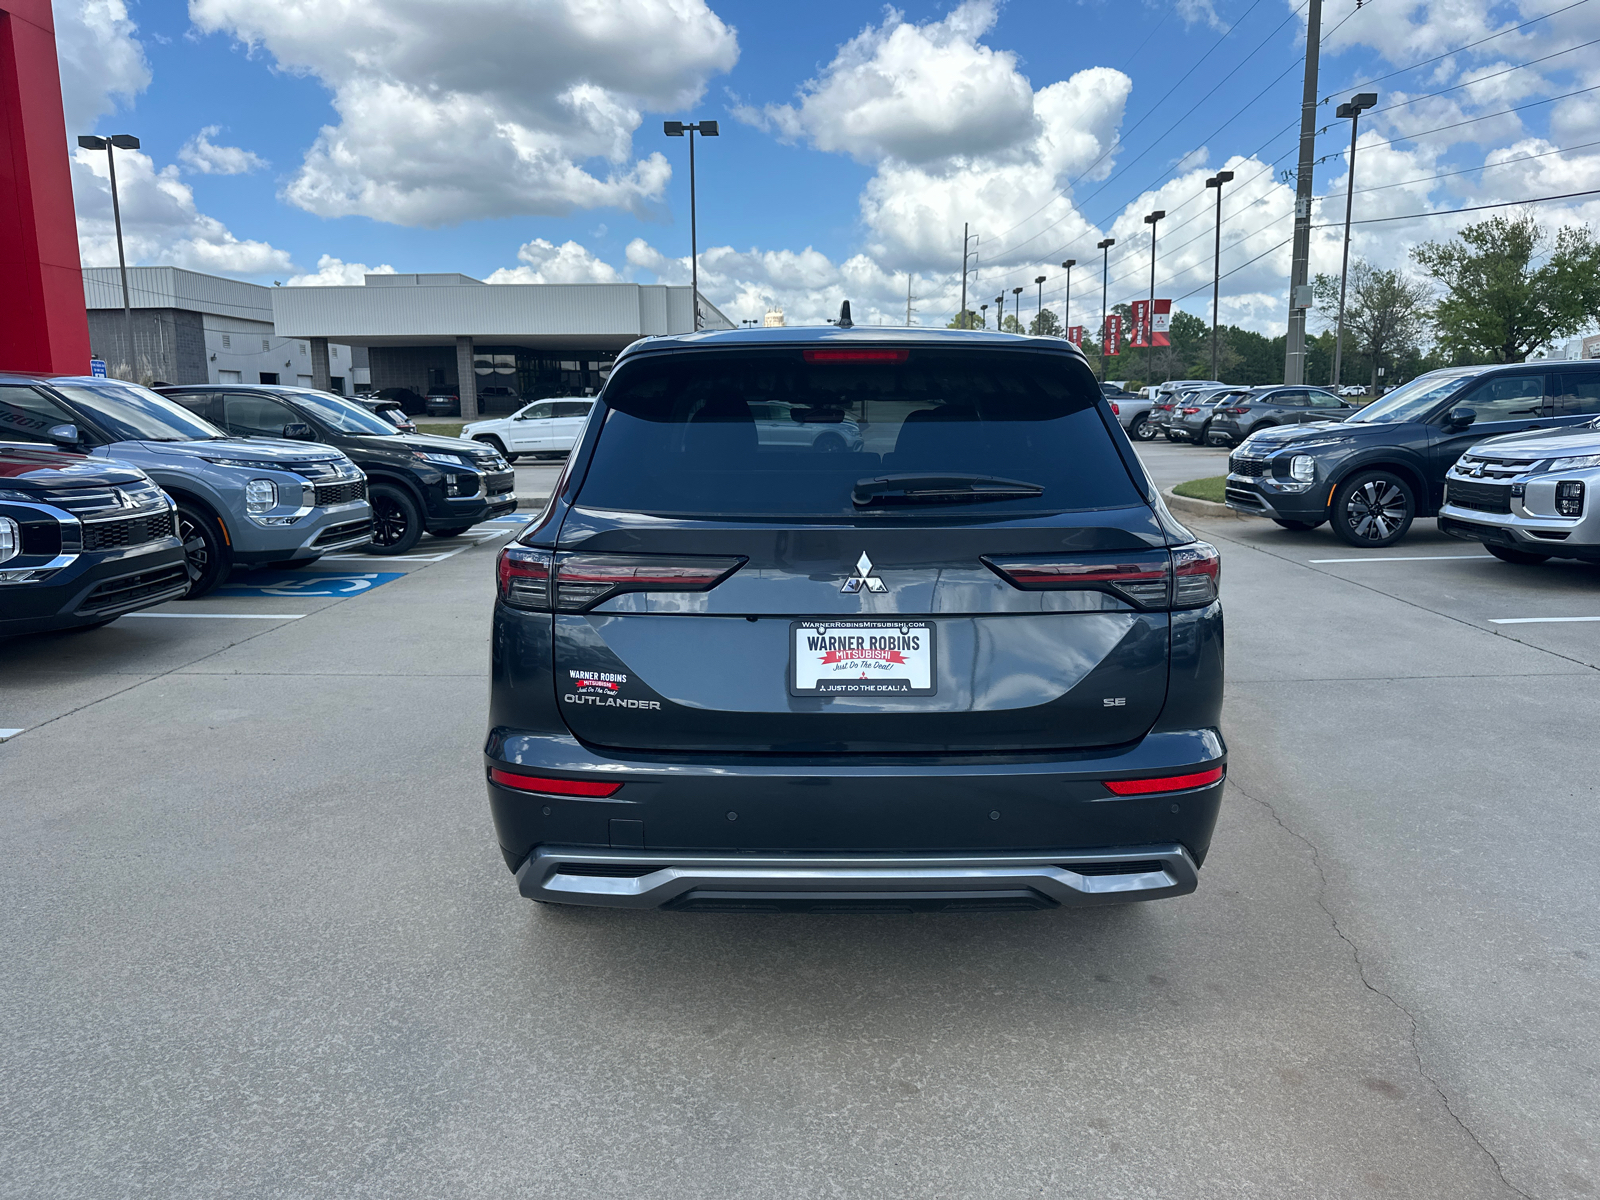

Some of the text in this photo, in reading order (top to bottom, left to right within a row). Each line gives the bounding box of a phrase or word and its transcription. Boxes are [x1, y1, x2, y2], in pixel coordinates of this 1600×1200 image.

[807, 636, 920, 651] WARNER ROBINS
[835, 650, 891, 659] MITSUBISHI
[832, 662, 848, 671] Just
[860, 661, 872, 669] The
[873, 662, 894, 670] Deal!
[570, 670, 627, 683] WARNER ROBINS
[564, 694, 661, 710] OUTLANDER
[1103, 698, 1126, 707] SE
